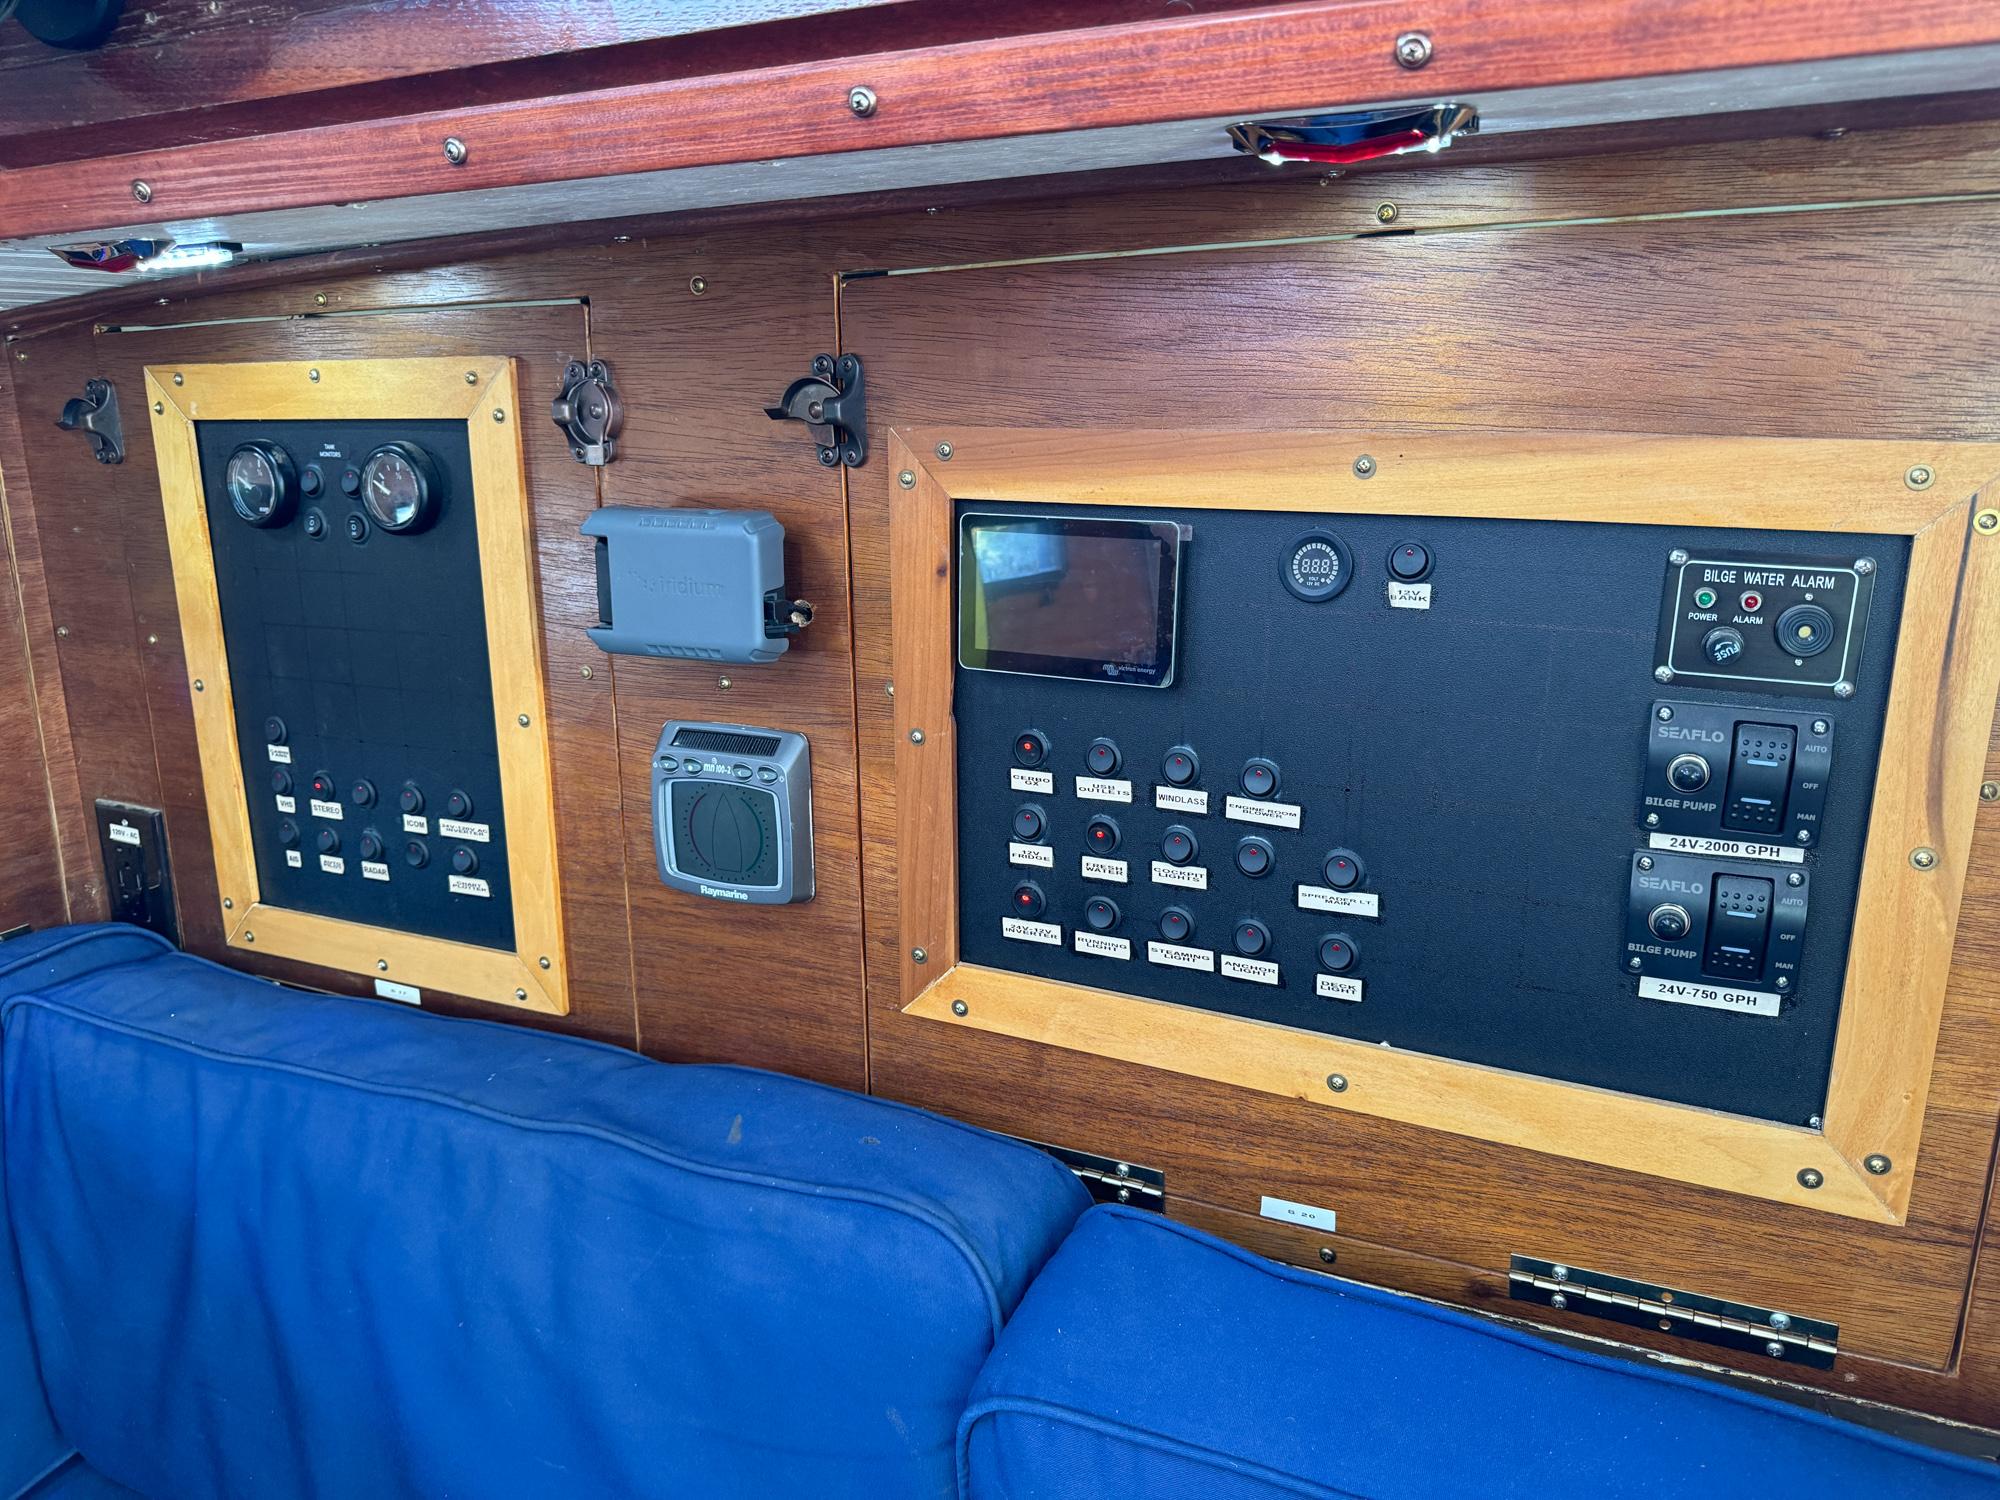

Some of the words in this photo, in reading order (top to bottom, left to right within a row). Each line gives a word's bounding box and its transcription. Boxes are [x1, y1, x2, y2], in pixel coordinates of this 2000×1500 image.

[1704, 569, 1737, 584] BILGE
[1744, 571, 1785, 587] WATER
[1791, 574, 1836, 590] ALARM
[1390, 594, 1428, 602] BANK
[1688, 612, 1718, 622] POWER
[1732, 615, 1764, 625] ALARM
[1714, 643, 1741, 661] FUSE
[1658, 726, 1725, 743] SEAFLO
[1804, 744, 1828, 753] AUTO
[1012, 774, 1051, 784] CERBO
[1802, 782, 1819, 790] OFF
[1078, 786, 1130, 797] OUTLETS
[280, 800, 294, 808] VHS
[1158, 793, 1206, 806] WINDLASS
[1645, 796, 1680, 808] BILGE
[1682, 800, 1717, 812] PUMP
[313, 804, 340, 814] STEREO
[1229, 803, 1264, 813] ENGINE
[1266, 808, 1297, 817] ROOM
[1242, 809, 1283, 819] BLOWER
[1796, 812, 1816, 821] MAN
[406, 820, 425, 828] ICOM
[1670, 837, 1740, 854] 24V-2000
[1744, 846, 1781, 858] GPH
[1012, 852, 1051, 862] FRIDGE
[364, 866, 387, 874] RADAR
[1085, 862, 1124, 871] FRESH
[1085, 866, 1124, 876] WATER
[1153, 866, 1204, 879] COCKPIT
[1158, 872, 1200, 882] LIGHTS
[1638, 877, 1704, 895] SEAFLO
[700, 884, 748, 900] Raymarine
[1301, 892, 1357, 904] SPREADER
[1781, 898, 1804, 906] AUTO
[1005, 927, 1058, 940] INVERTER
[1010, 924, 1052, 935] 24V-12V
[1077, 936, 1128, 950] RUNNING
[1086, 942, 1117, 952] LIGHT
[1151, 947, 1210, 961] STEAMING
[1628, 942, 1662, 955] BILGE
[1664, 947, 1697, 960] PUMP
[1164, 954, 1196, 963] LIGHT
[1224, 960, 1276, 974] ANCHOR
[1775, 962, 1794, 970] MAN
[1232, 966, 1268, 977] LIGHT
[1320, 985, 1358, 995] LIGHT
[1321, 980, 1357, 991] DECK
[1658, 983, 1718, 1000] 24V-750
[1722, 993, 1758, 1006] GPH
